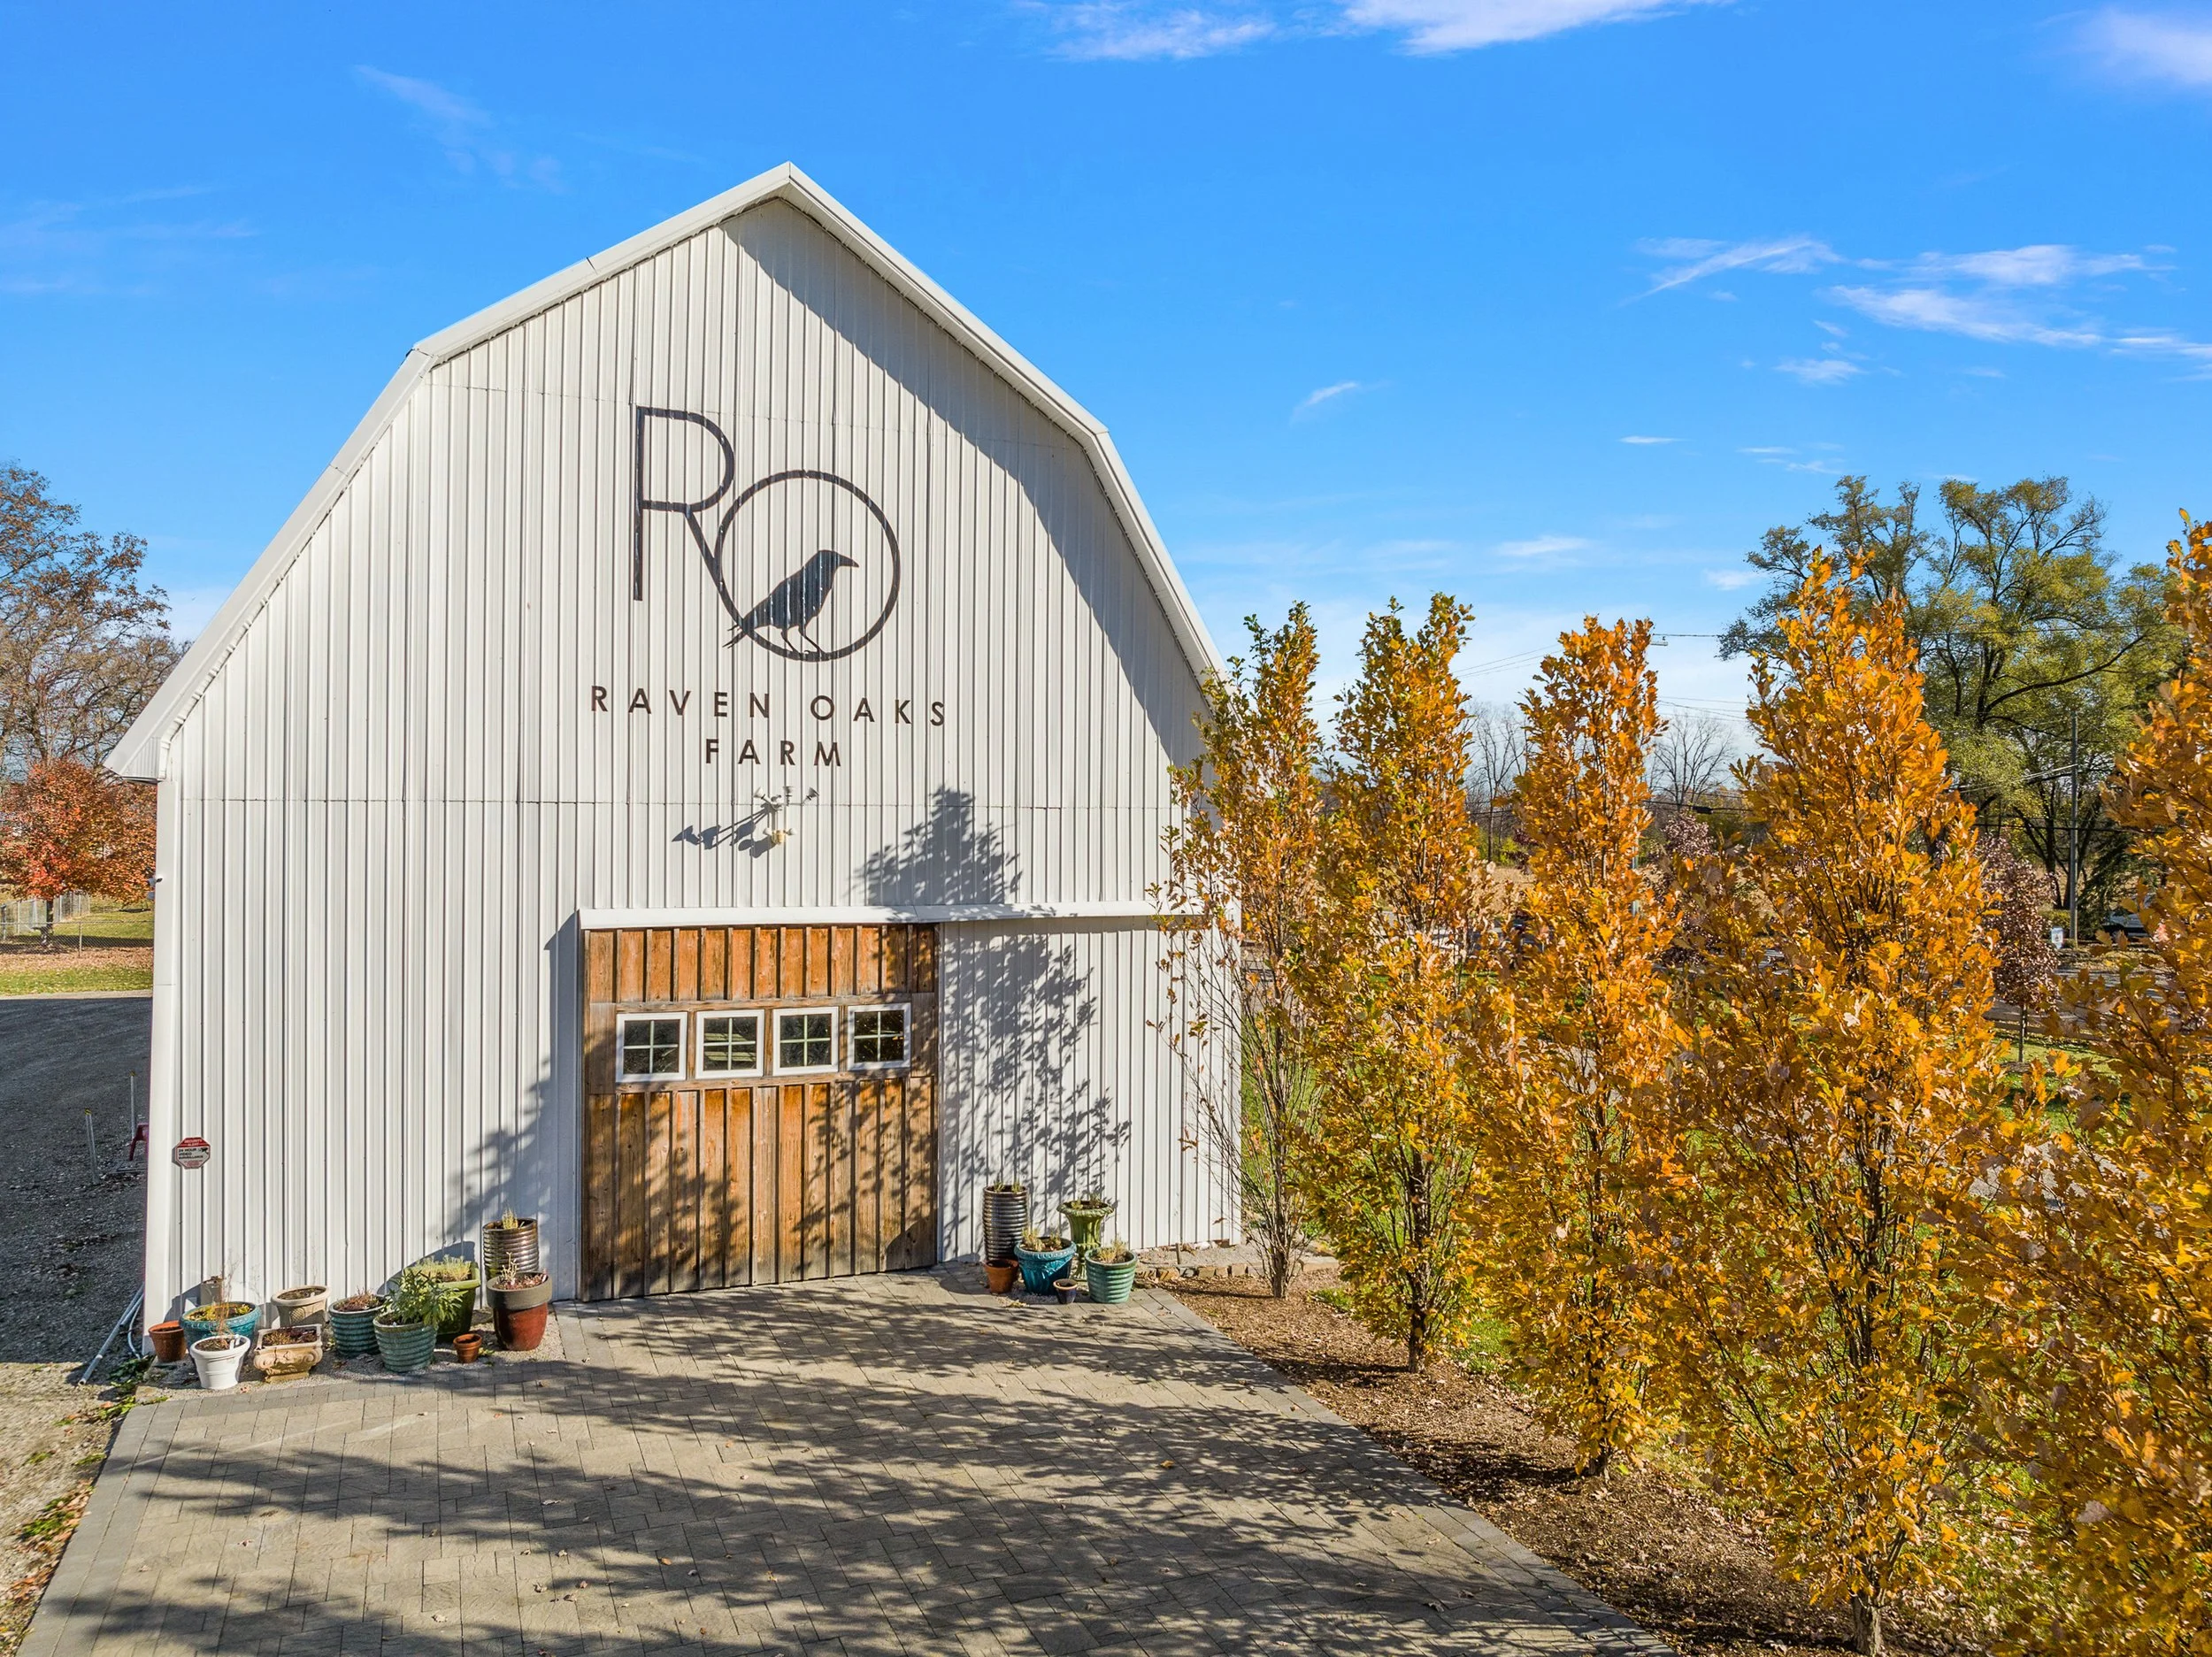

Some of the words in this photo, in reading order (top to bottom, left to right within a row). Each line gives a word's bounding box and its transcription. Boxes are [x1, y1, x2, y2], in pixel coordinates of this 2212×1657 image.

[591, 685, 770, 719] RAVEN
[810, 694, 946, 726] OAKS
[705, 738, 841, 767] FARM
